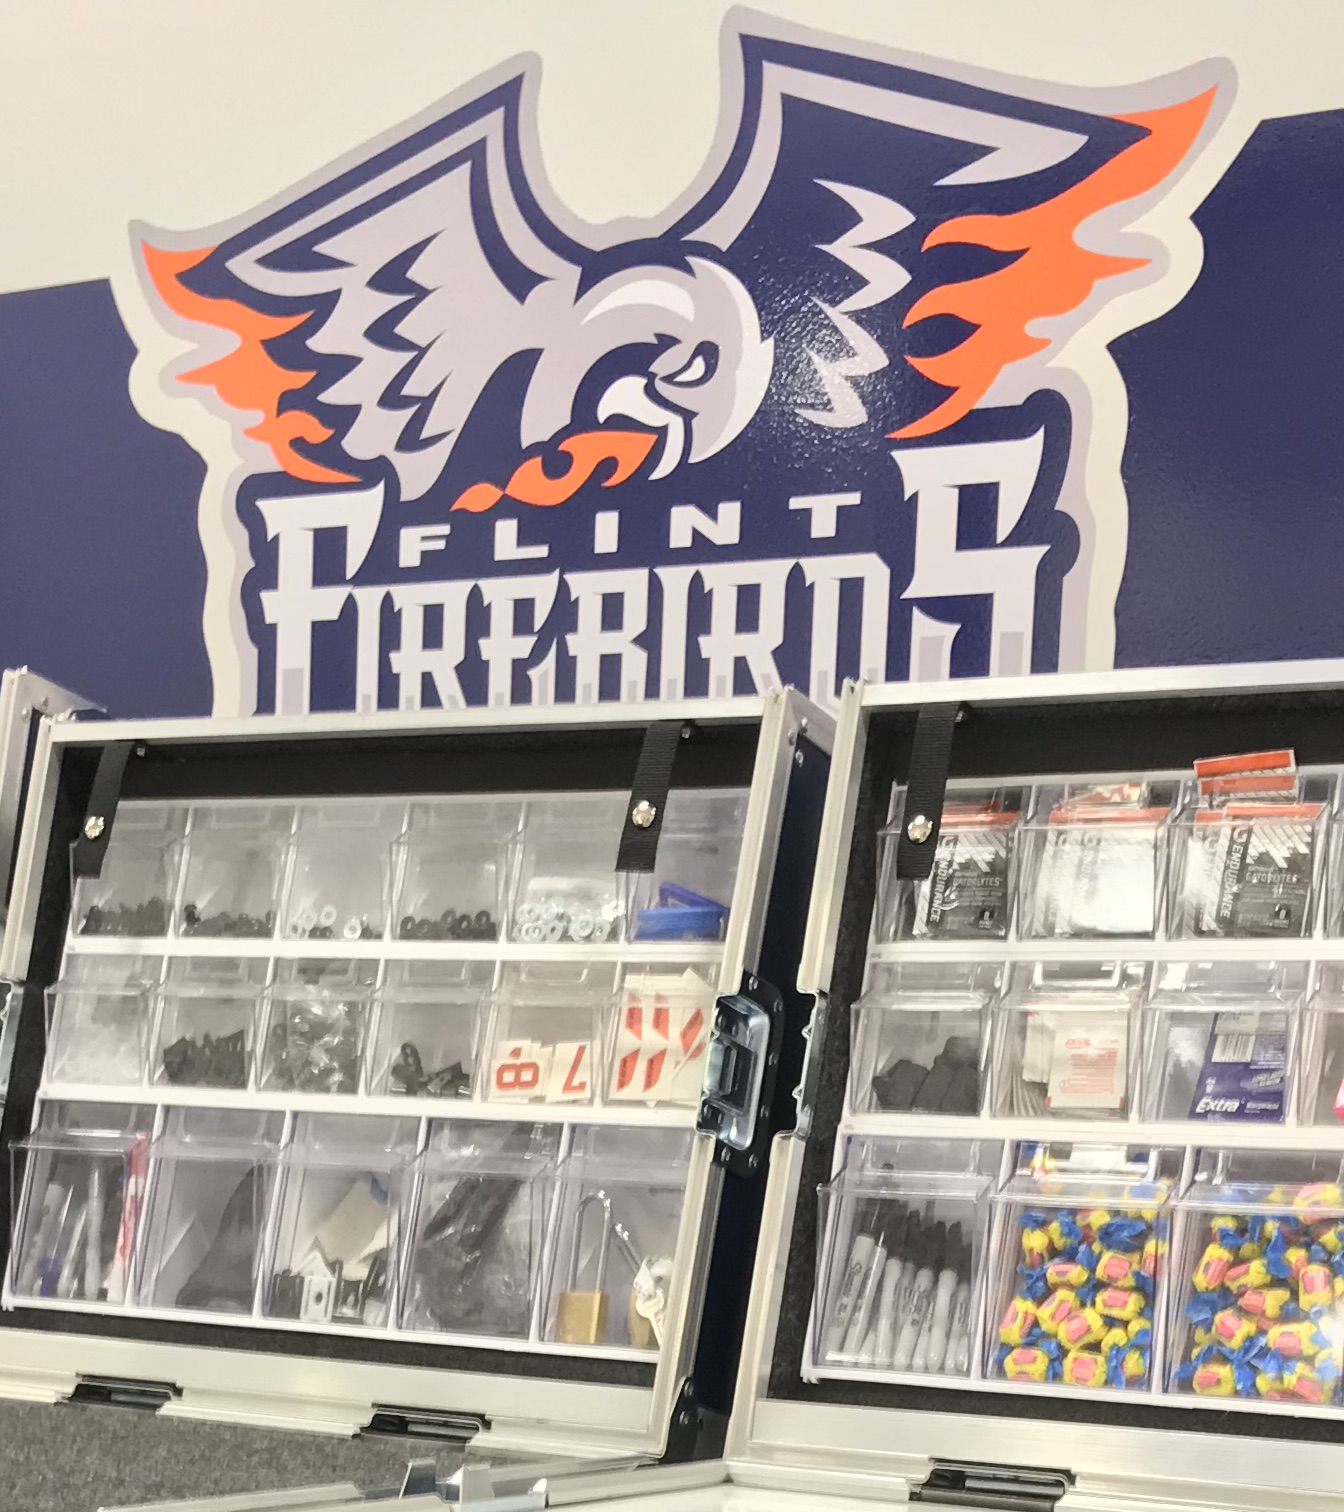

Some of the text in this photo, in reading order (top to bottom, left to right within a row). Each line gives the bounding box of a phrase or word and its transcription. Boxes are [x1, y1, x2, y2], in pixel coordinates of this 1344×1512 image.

[397, 492, 863, 568] FLINT
[256, 428, 1054, 716] FIREBIRDS
[1219, 845, 1245, 921] ENDURANCE
[495, 1061, 540, 1091] 8
[1195, 1095, 1242, 1114] Extra
